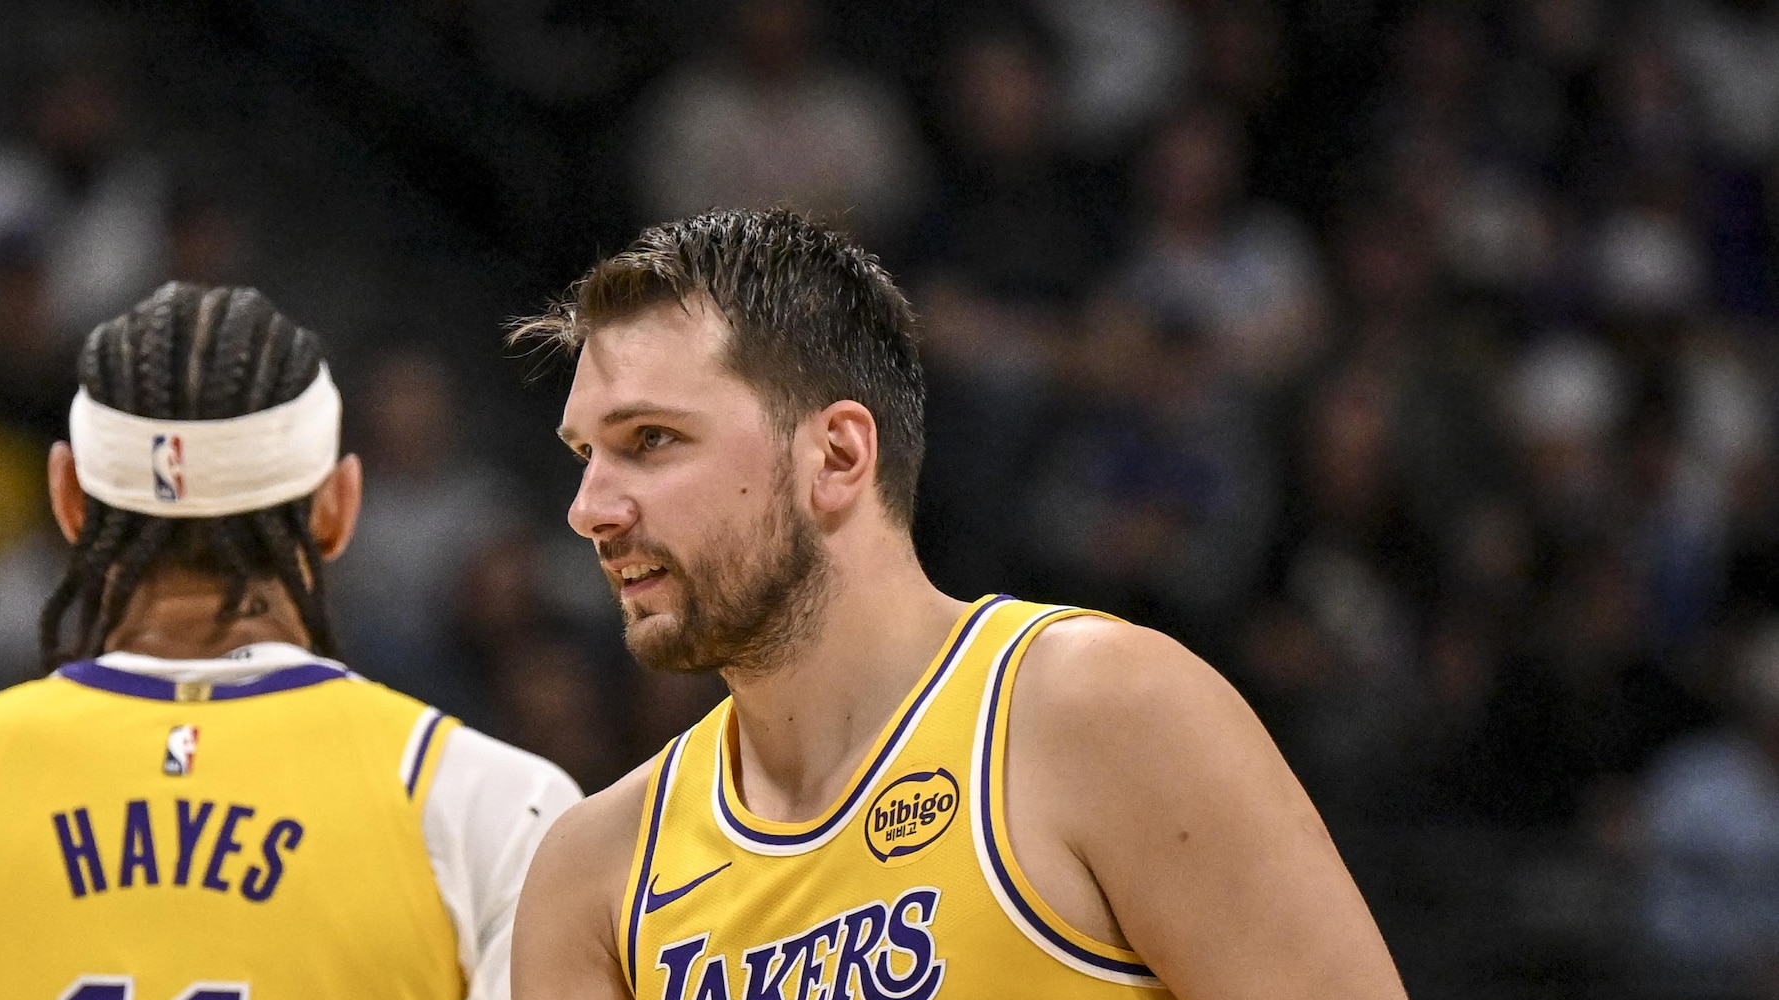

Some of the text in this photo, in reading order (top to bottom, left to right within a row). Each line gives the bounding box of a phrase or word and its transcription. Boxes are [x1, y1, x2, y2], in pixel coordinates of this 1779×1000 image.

[874, 792, 954, 832] bibigo
[885, 821, 917, 842] 비비고
[52, 797, 305, 903] HAYES
